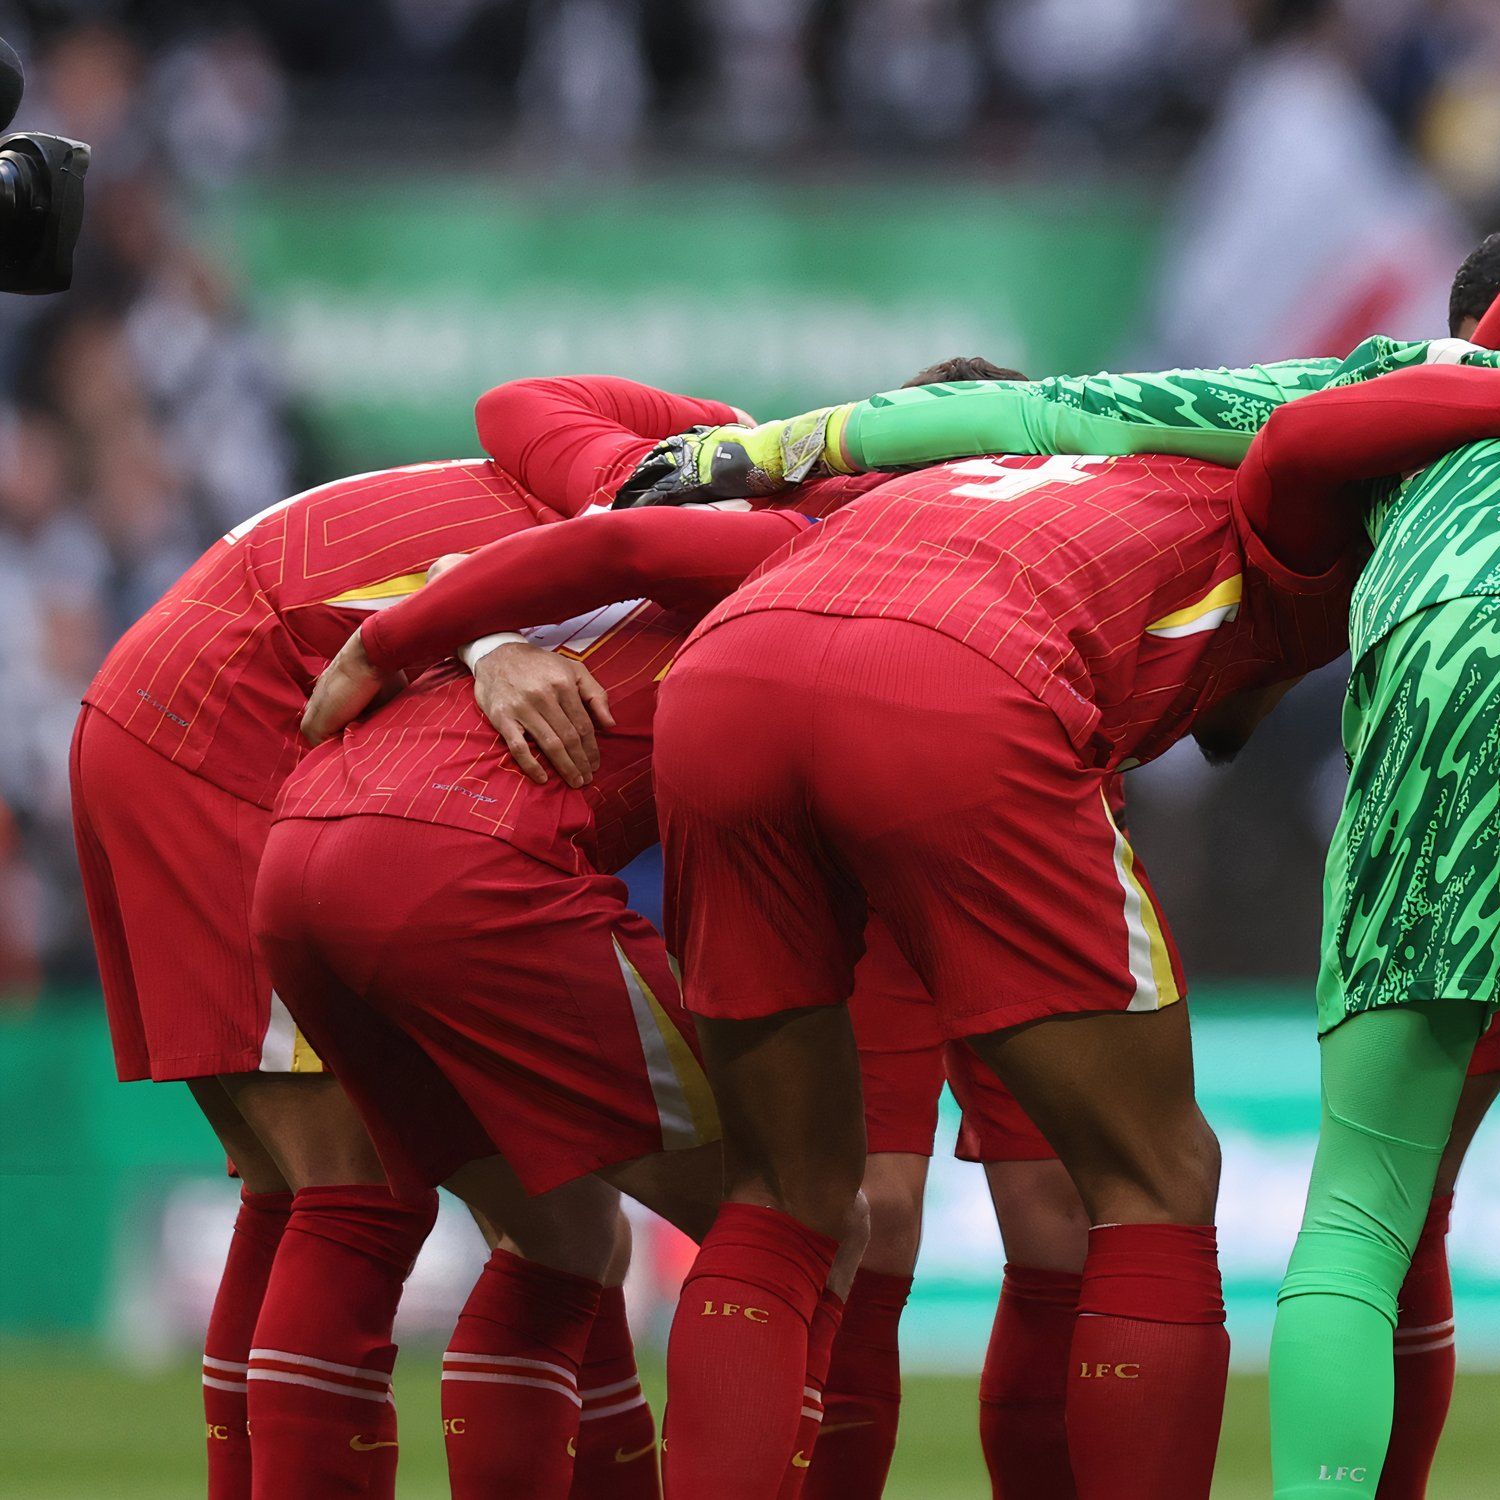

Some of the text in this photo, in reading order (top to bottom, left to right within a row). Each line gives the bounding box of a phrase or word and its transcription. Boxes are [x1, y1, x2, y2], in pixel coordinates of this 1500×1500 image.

[701, 1300, 769, 1323] LFC
[1080, 1362, 1140, 1379] LFC
[207, 1423, 228, 1439] FC
[443, 1418, 465, 1435] FC
[1319, 1465, 1367, 1482] LFC
